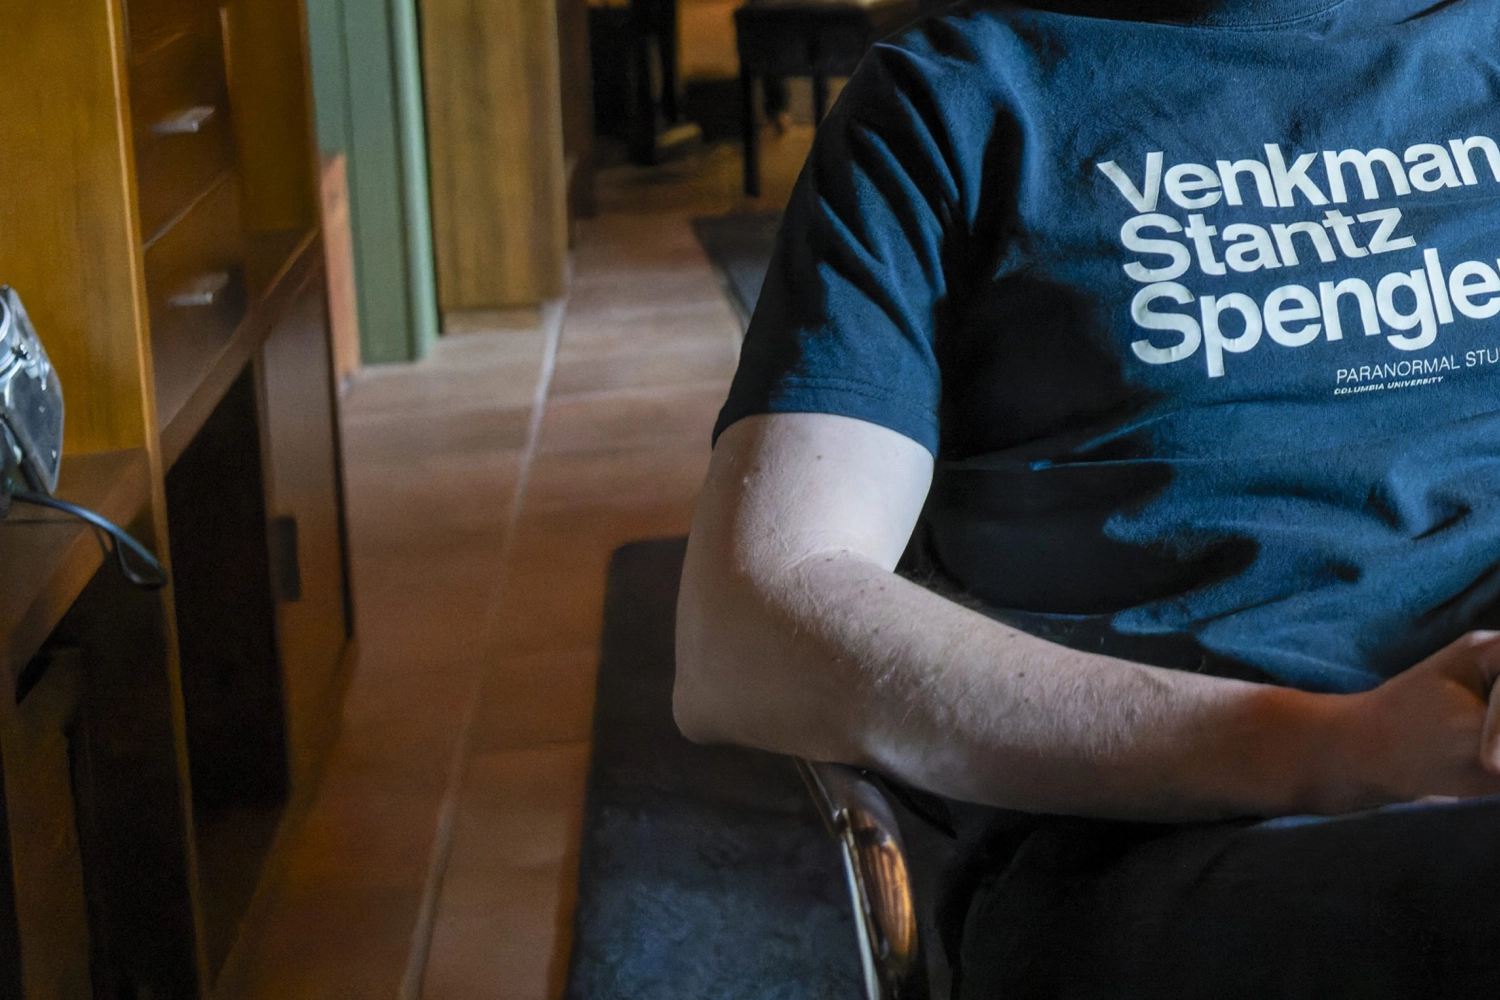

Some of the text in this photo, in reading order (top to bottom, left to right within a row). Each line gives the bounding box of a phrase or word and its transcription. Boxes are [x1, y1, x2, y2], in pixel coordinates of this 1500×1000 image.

[1120, 207, 1416, 283] Stantz
[1336, 355, 1460, 384] PARANORMAL
[1334, 376, 1443, 395] COLUMBIA UNIVERSITY
